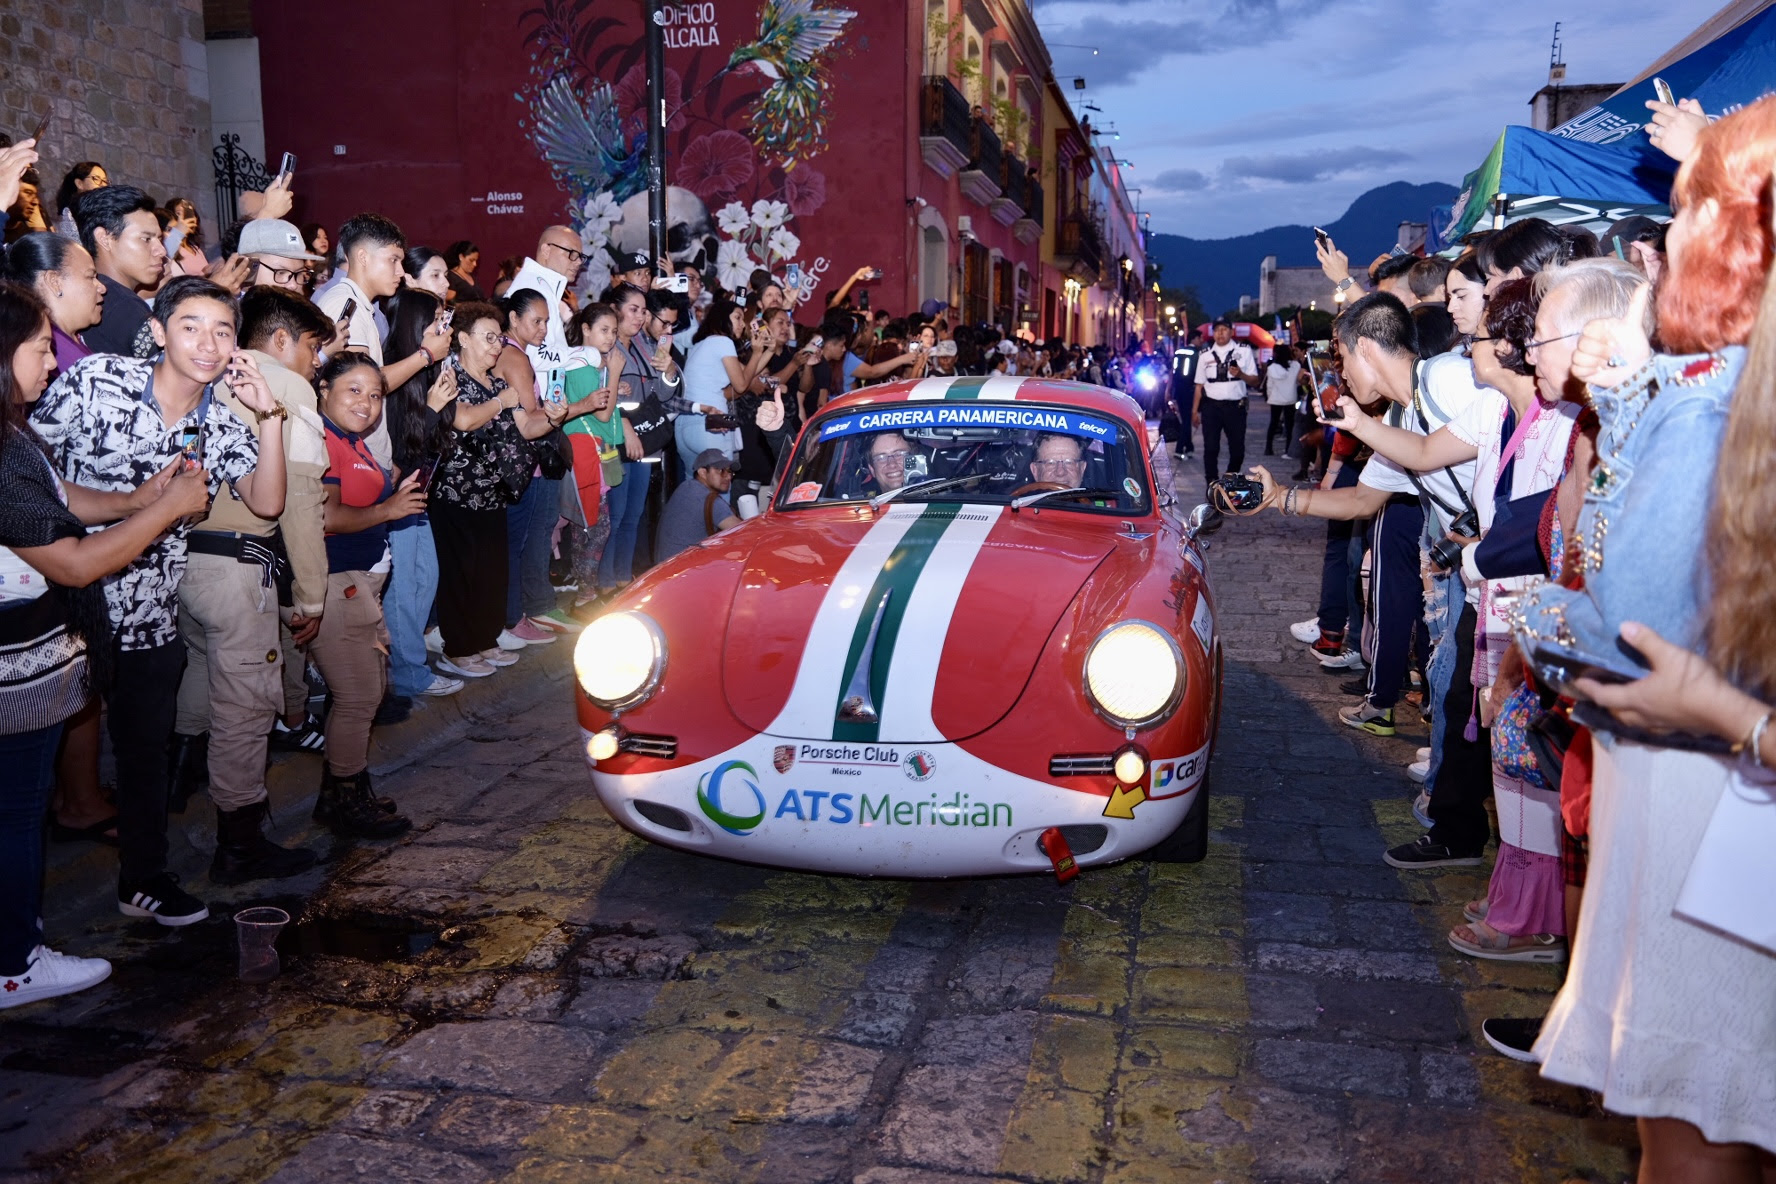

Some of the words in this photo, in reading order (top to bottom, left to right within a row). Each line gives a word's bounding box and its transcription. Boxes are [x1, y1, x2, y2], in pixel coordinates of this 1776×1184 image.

[663, 2, 715, 26] DIFICIO
[487, 191, 523, 202] Alonso
[487, 203, 524, 215] Chávez
[824, 421, 852, 435] telcel
[859, 410, 935, 429] CARRERA
[937, 409, 1069, 430] PANAMERICANA
[1078, 421, 1107, 435] telcel
[800, 745, 861, 760] Porsche
[864, 746, 899, 763] Club
[832, 767, 862, 776] México
[774, 788, 854, 824] ATS
[859, 791, 1013, 827] Meridian
